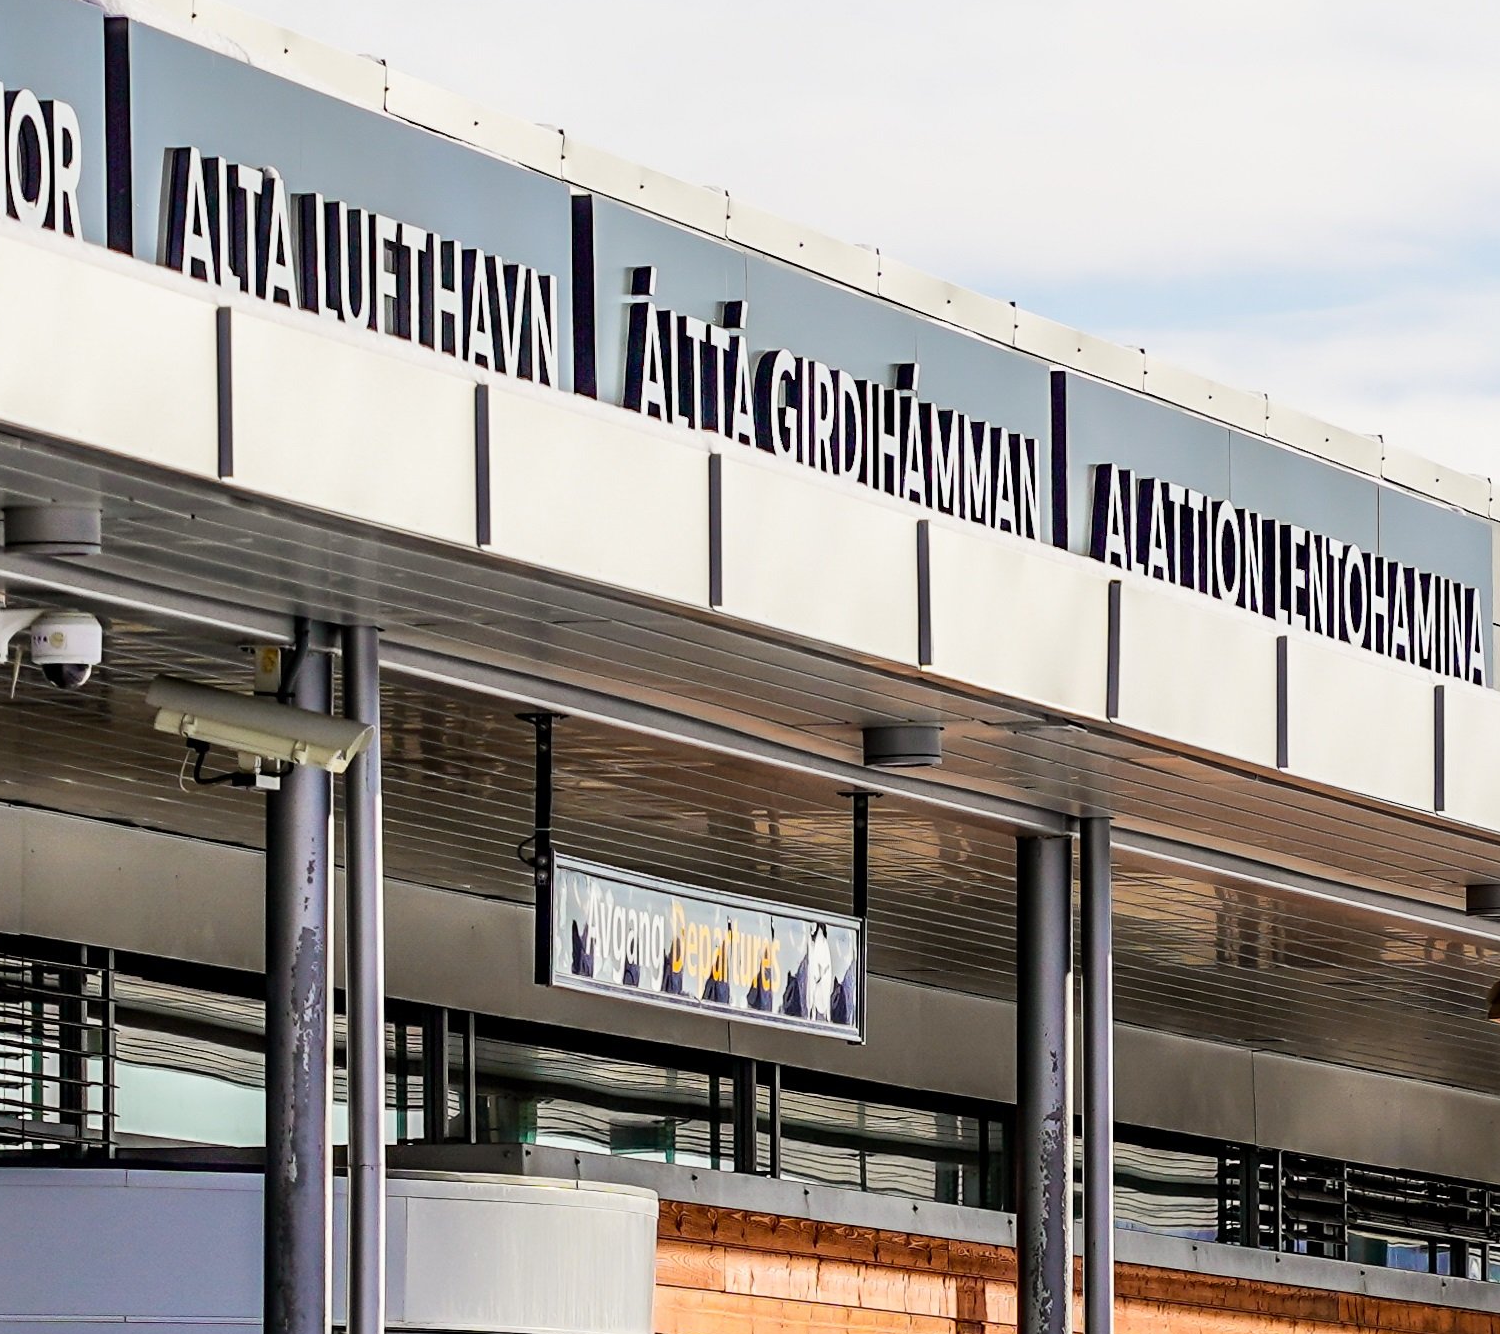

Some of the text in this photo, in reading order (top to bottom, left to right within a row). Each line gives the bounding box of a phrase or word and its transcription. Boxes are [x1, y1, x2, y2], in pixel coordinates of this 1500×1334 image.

[172, 145, 559, 391] ALTA LUFTHAVN
[632, 266, 1042, 543] ÁLTTÁ GIRDIHÁMMAN
[1097, 463, 1489, 689] ALATTION LENTOHAMINA
[586, 880, 781, 1002] Avgang Departures
